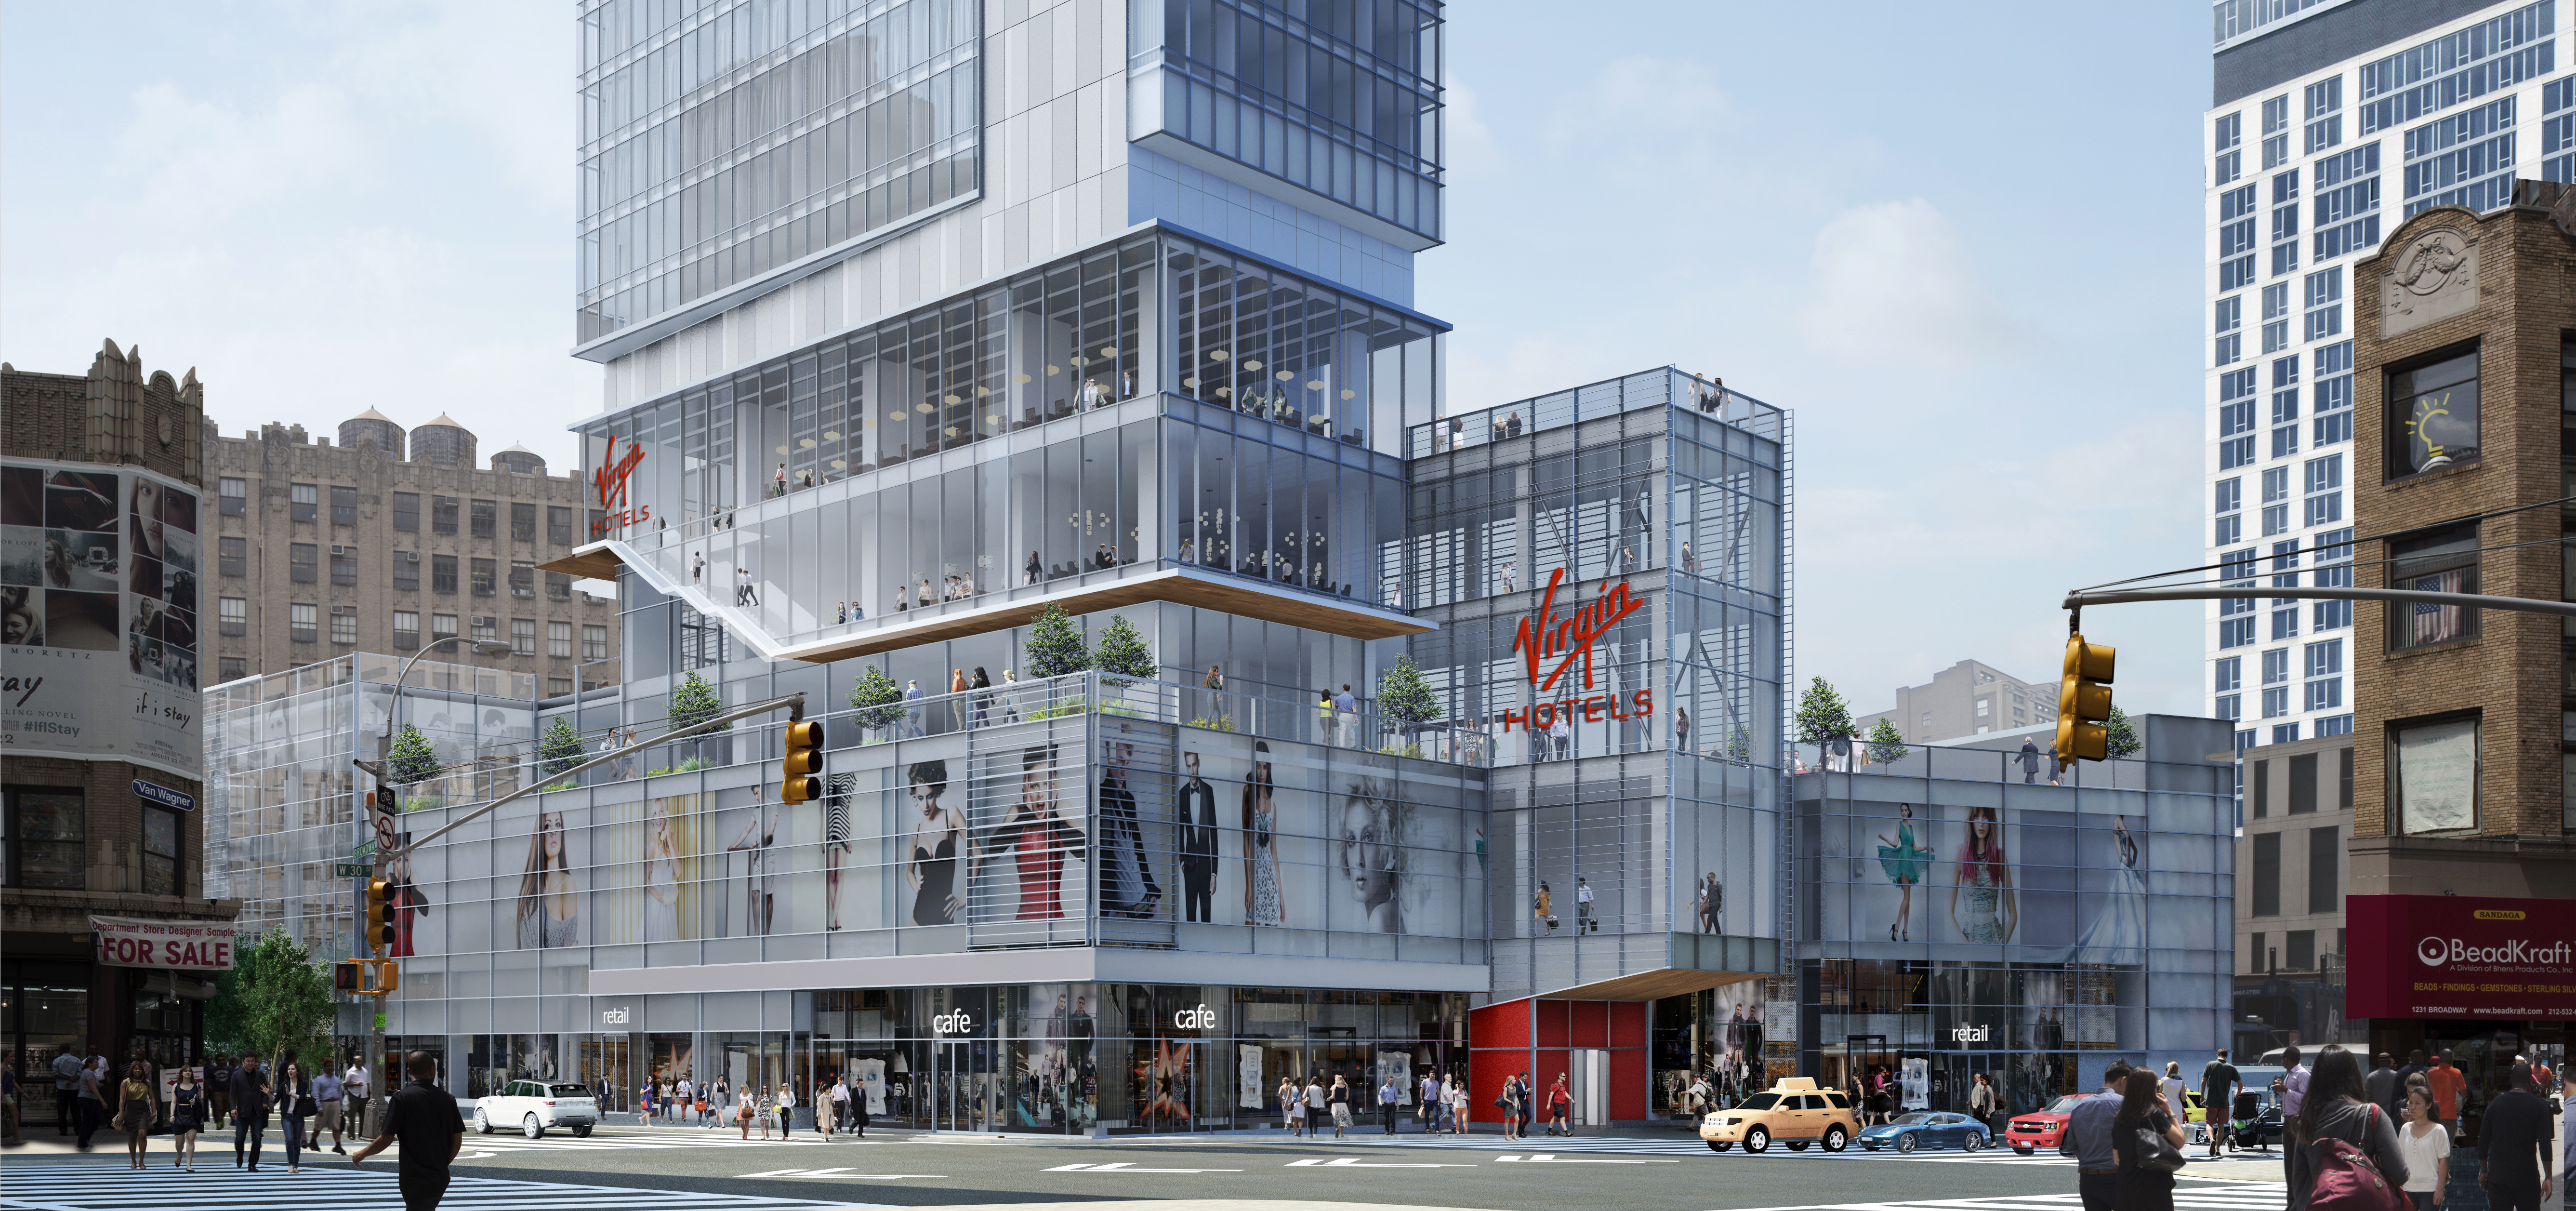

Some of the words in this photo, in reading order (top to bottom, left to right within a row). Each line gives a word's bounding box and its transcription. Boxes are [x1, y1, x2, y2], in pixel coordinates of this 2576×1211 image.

[596, 435, 645, 509] Virgin
[593, 505, 649, 535] HOTELS
[1514, 567, 1644, 691] Virgin
[11, 648, 91, 659] MORETZ
[0, 668, 43, 707] ay
[153, 682, 171, 691] GRACE
[174, 689, 195, 699] MORETZ
[39, 711, 76, 719] NOVEL
[137, 692, 148, 714] if
[164, 706, 191, 729] stay
[1506, 690, 1653, 732] HOTELS
[151, 752, 170, 761] AUGUST
[138, 781, 156, 797] Van
[158, 788, 191, 807] Wagner
[386, 805, 395, 813] PATH
[339, 865, 346, 876] W
[350, 865, 362, 876] 30
[92, 921, 139, 933] Department
[144, 924, 165, 934] Store
[169, 926, 203, 937] Designer
[207, 927, 234, 938] Sample
[103, 937, 154, 964] FOR
[165, 941, 228, 967] SALE
[2451, 938, 2571, 964] BeadKraft
[2414, 983, 2438, 991] BEADS
[2443, 983, 2475, 991] FINDINGS
[2481, 984, 2523, 992] GEMSTONES
[2527, 985, 2561, 993] STERLING
[603, 1006, 629, 1024] retail
[933, 1008, 971, 1033] cafe
[1175, 1003, 1215, 1029] cafe
[1952, 1024, 1988, 1042] retail
